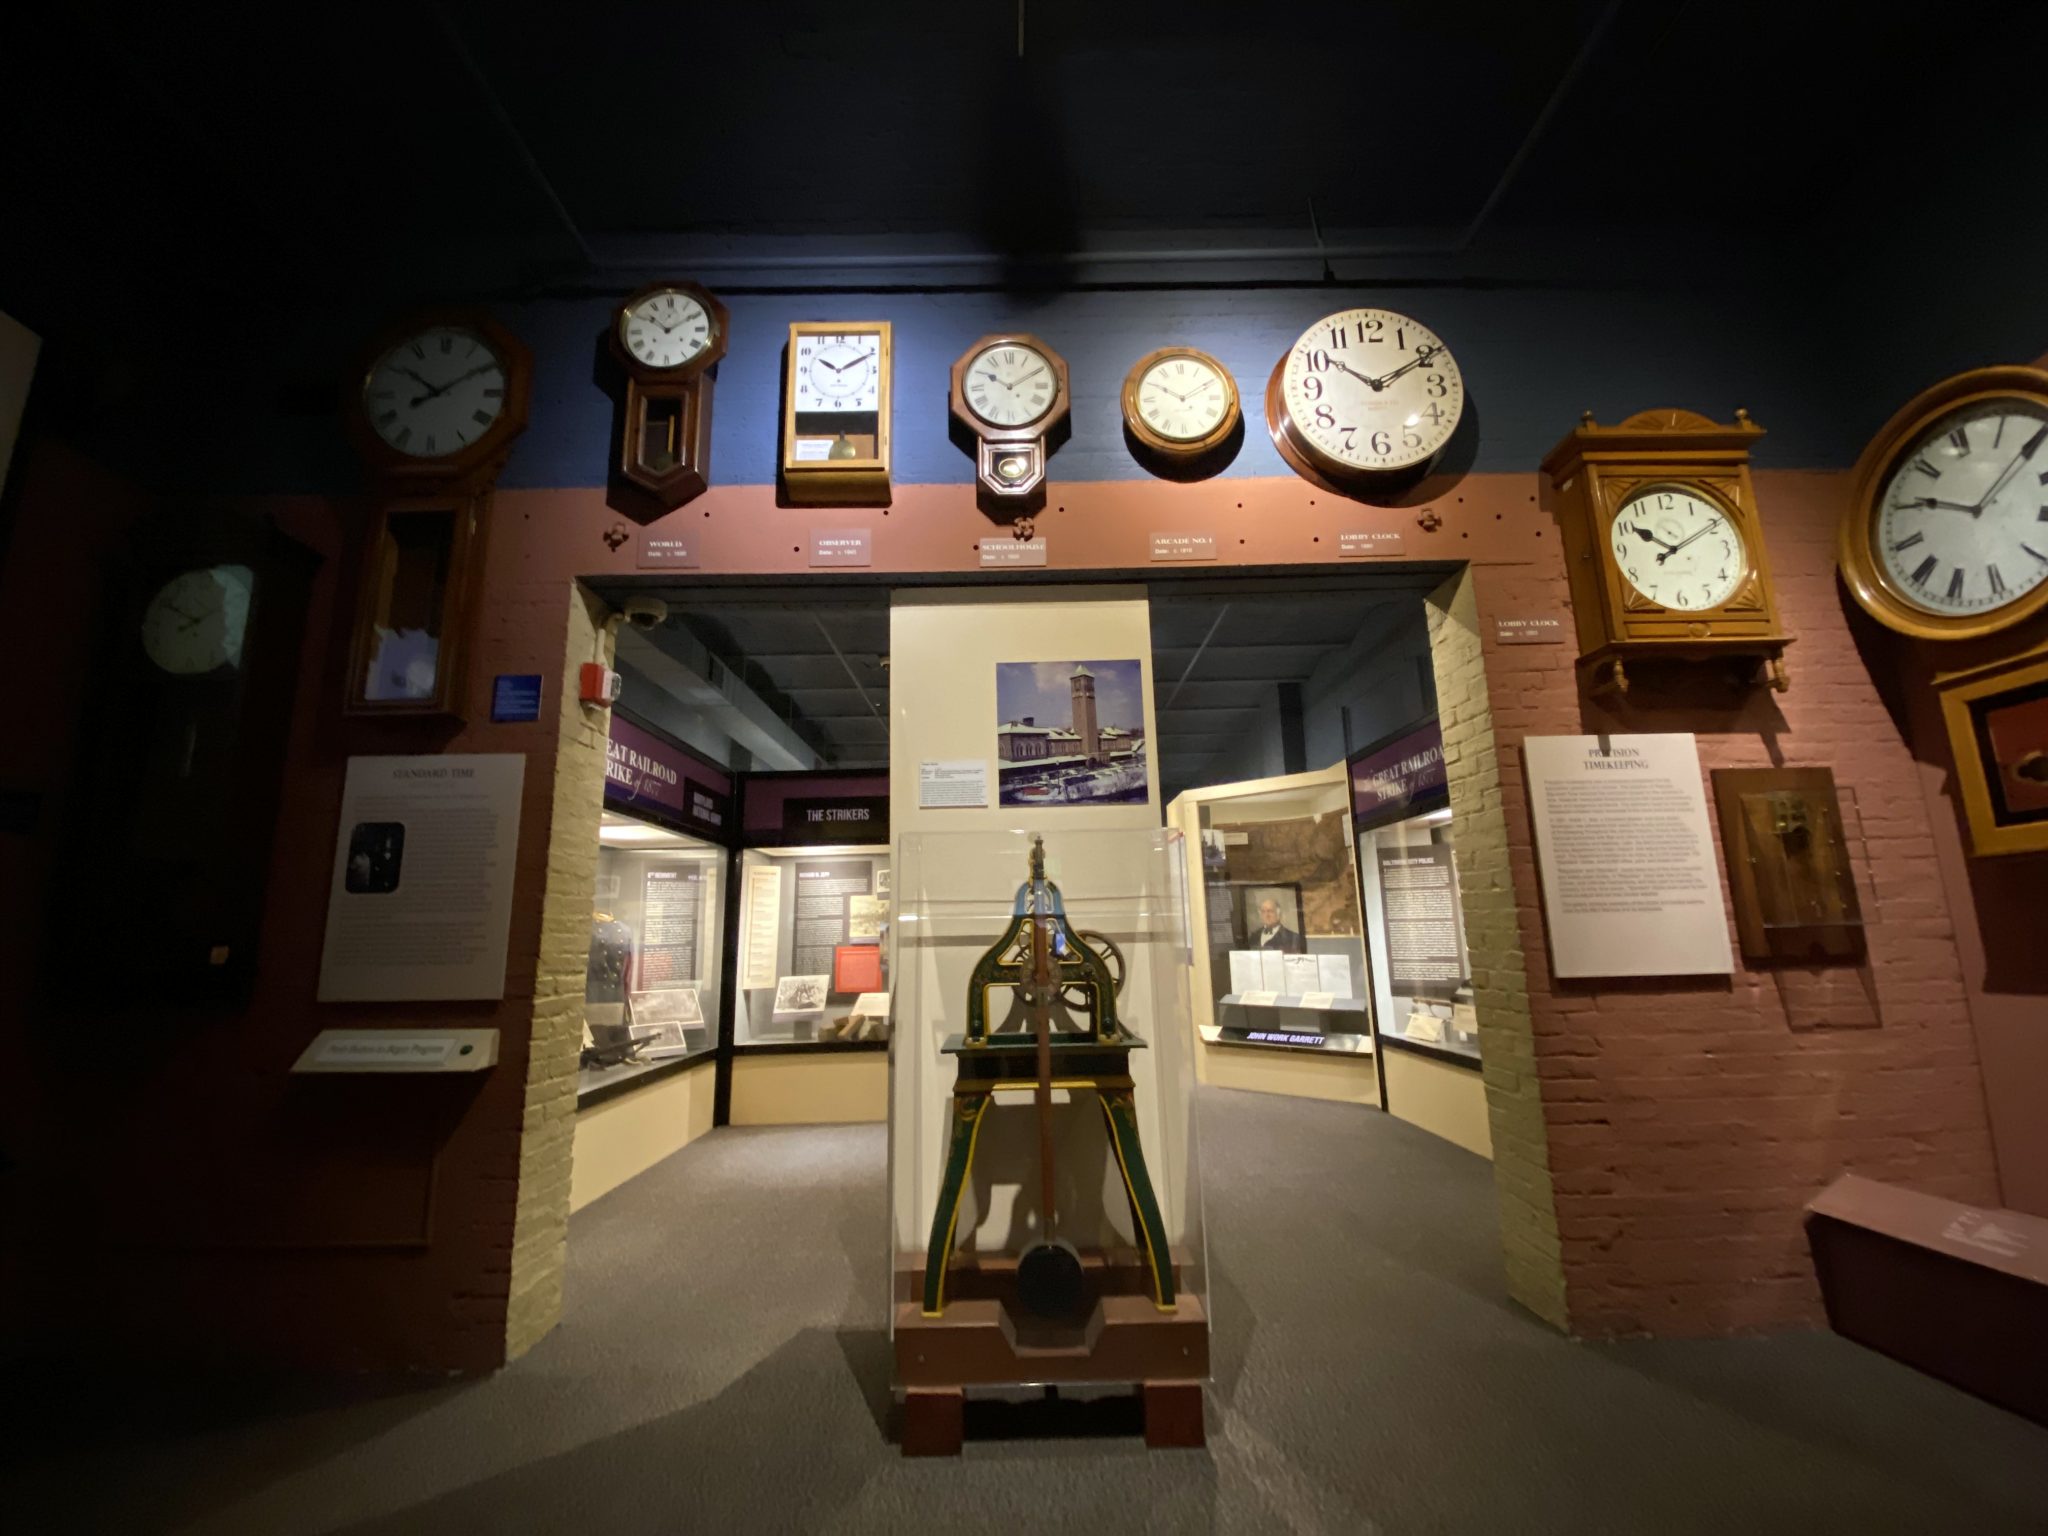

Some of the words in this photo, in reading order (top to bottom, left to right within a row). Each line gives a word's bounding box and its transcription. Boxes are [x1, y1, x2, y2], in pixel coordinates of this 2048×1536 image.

[817, 336, 825, 344] 11
[1330, 326, 1348, 349] 11
[1356, 320, 1384, 343] 12
[1398, 327, 1406, 350] 1
[801, 348, 811, 356] 10
[1416, 345, 1433, 367] 2
[1306, 350, 1330, 372] 10
[800, 366, 807, 374] 9
[1304, 376, 1322, 400] 9
[1427, 374, 1446, 397] 3
[816, 398, 823, 407] 7
[834, 400, 841, 408] 6
[1316, 405, 1336, 429] 8
[1421, 402, 1445, 425] 4
[1340, 428, 1358, 450] 7
[1372, 432, 1392, 455] 6
[1402, 425, 1422, 448] 5
[1633, 501, 1646, 517] 11
[1657, 494, 1673, 510] 12
[1688, 502, 1694, 516] 1
[1618, 520, 1634, 536] 10
[1616, 544, 1627, 560] 9
[1721, 540, 1731, 560] 3
[1628, 567, 1638, 583] 8
[1718, 568, 1729, 582] 4
[1650, 585, 1658, 600] 7
[1677, 590, 1688, 607] 6
[1702, 584, 1711, 601] 5
[1588, 748, 1639, 757] PRISION
[607, 739, 628, 762] EAT
[629, 750, 677, 785] RAILROAD
[1584, 760, 1648, 770] TIMEKEEPING
[393, 768, 448, 779] STANDARD
[451, 768, 475, 778] TIME
[607, 759, 632, 785] RIKE
[1372, 764, 1400, 787] GREAT
[1377, 778, 1407, 802] STRIKE
[807, 809, 824, 821] THE
[826, 808, 870, 821] STRIKERS
[1247, 1032, 1267, 1040] JOHN
[1266, 1033, 1290, 1042] WORK
[1289, 1034, 1325, 1044] GARRETT
